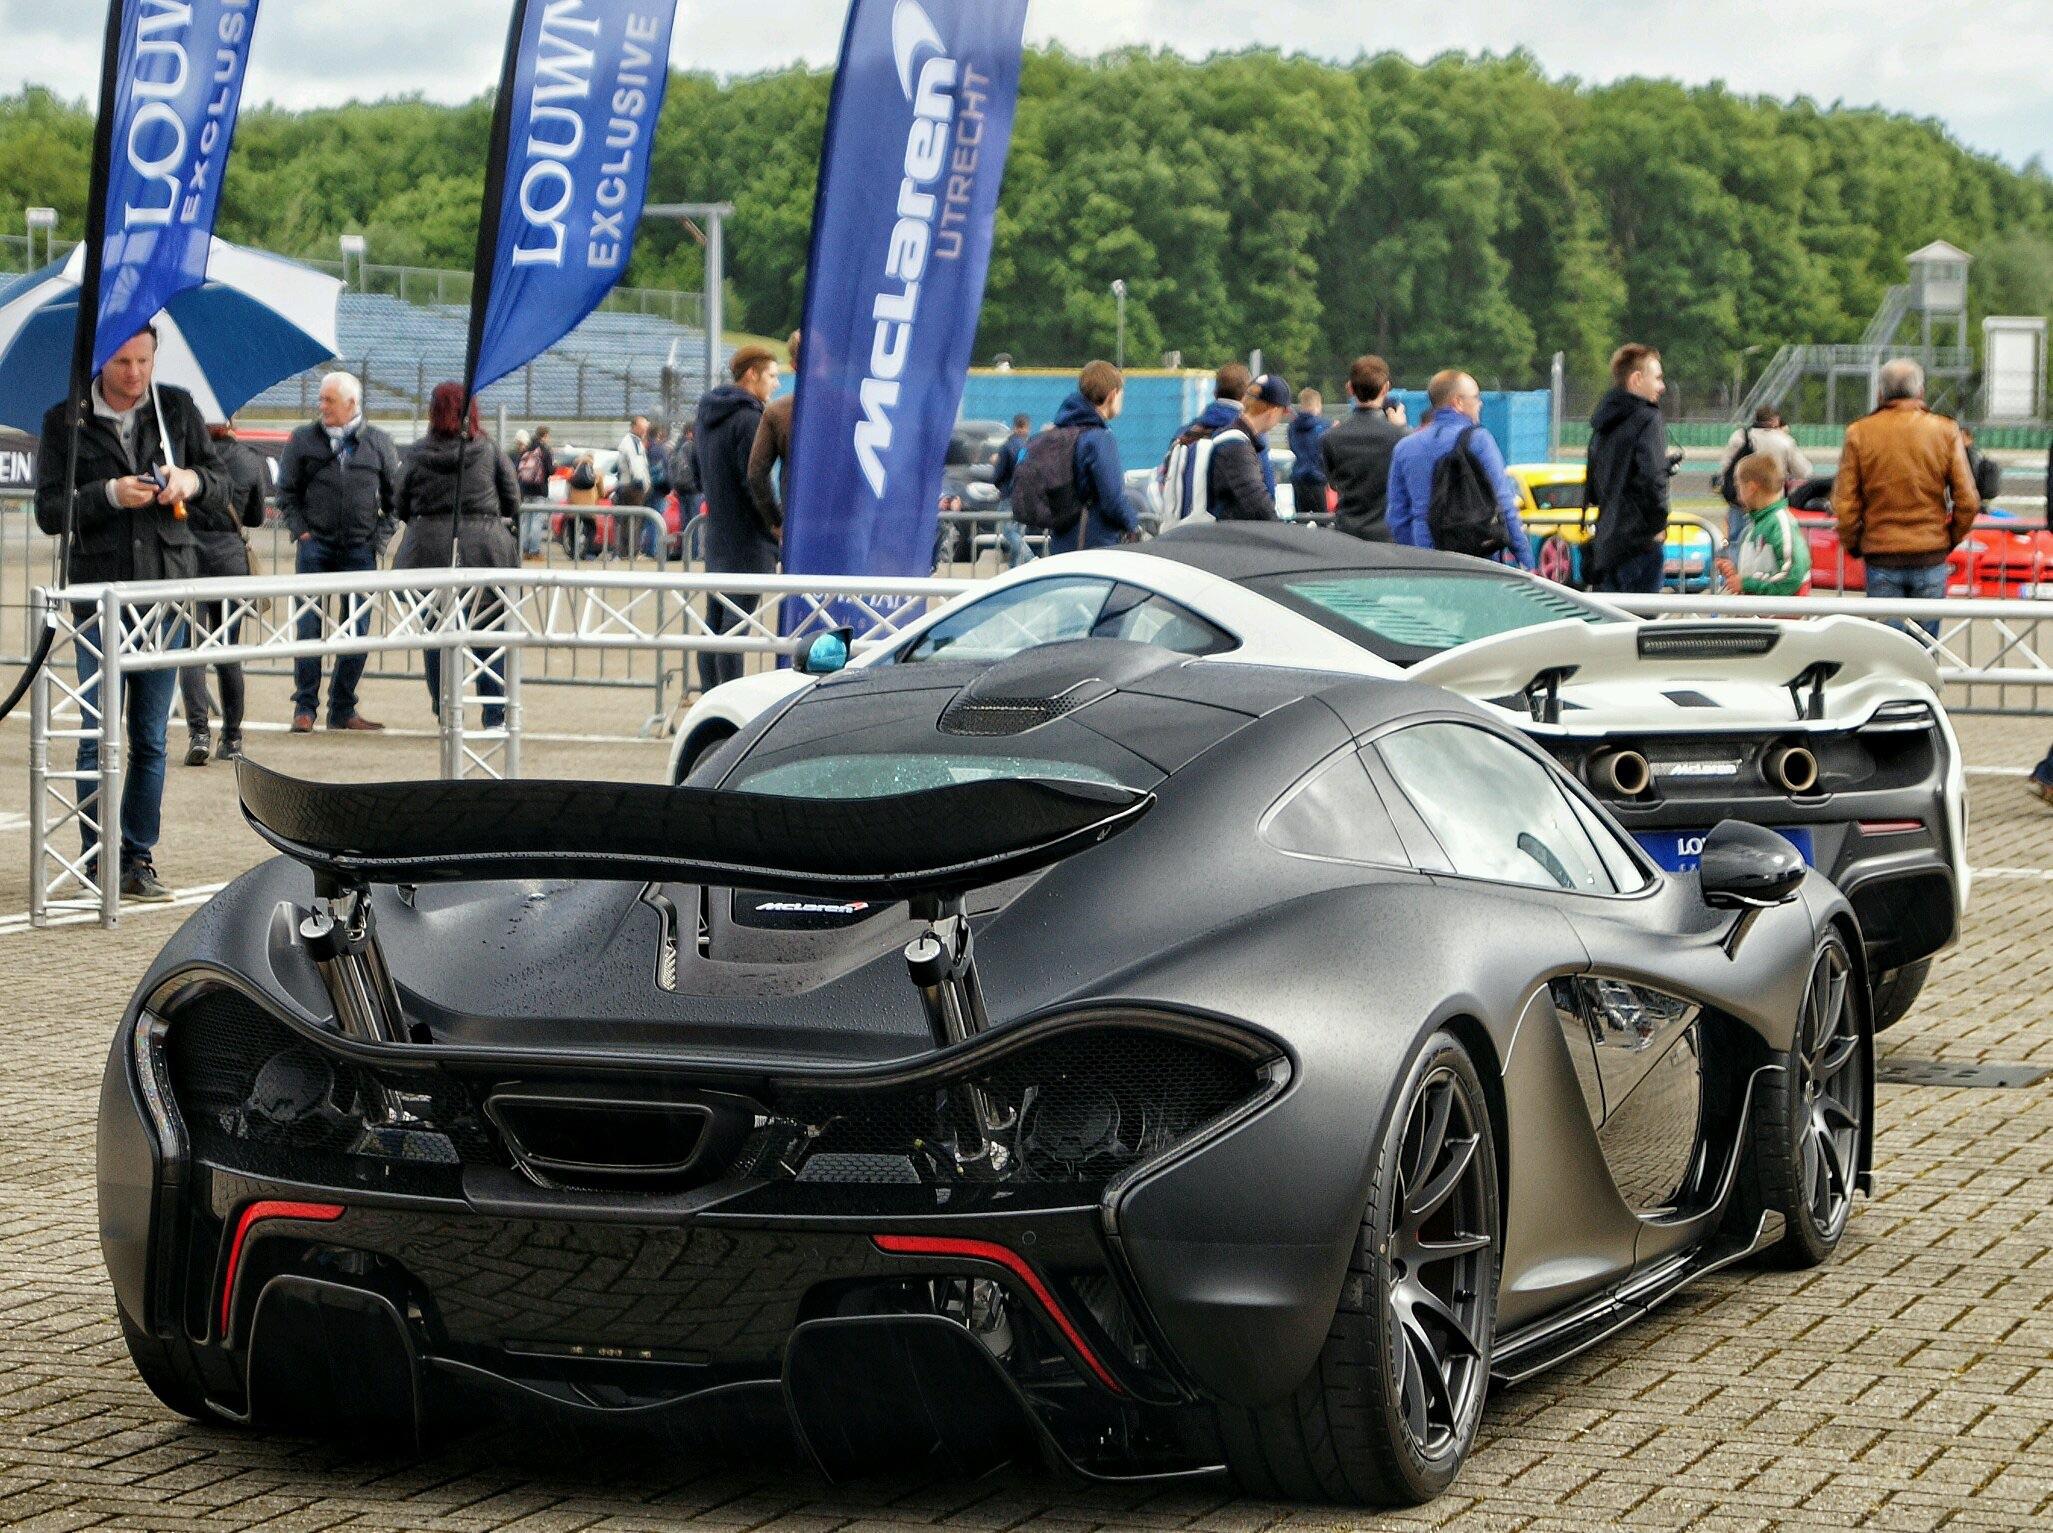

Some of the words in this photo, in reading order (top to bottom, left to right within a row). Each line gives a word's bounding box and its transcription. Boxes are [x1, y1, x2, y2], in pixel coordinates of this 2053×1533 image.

[587, 12, 660, 269] EXCLUSIVE
[935, 62, 989, 260] UTRECHT
[854, 56, 958, 499] McLaren
[755, 902, 854, 914] McLaren
[1677, 836, 1707, 856] LO
